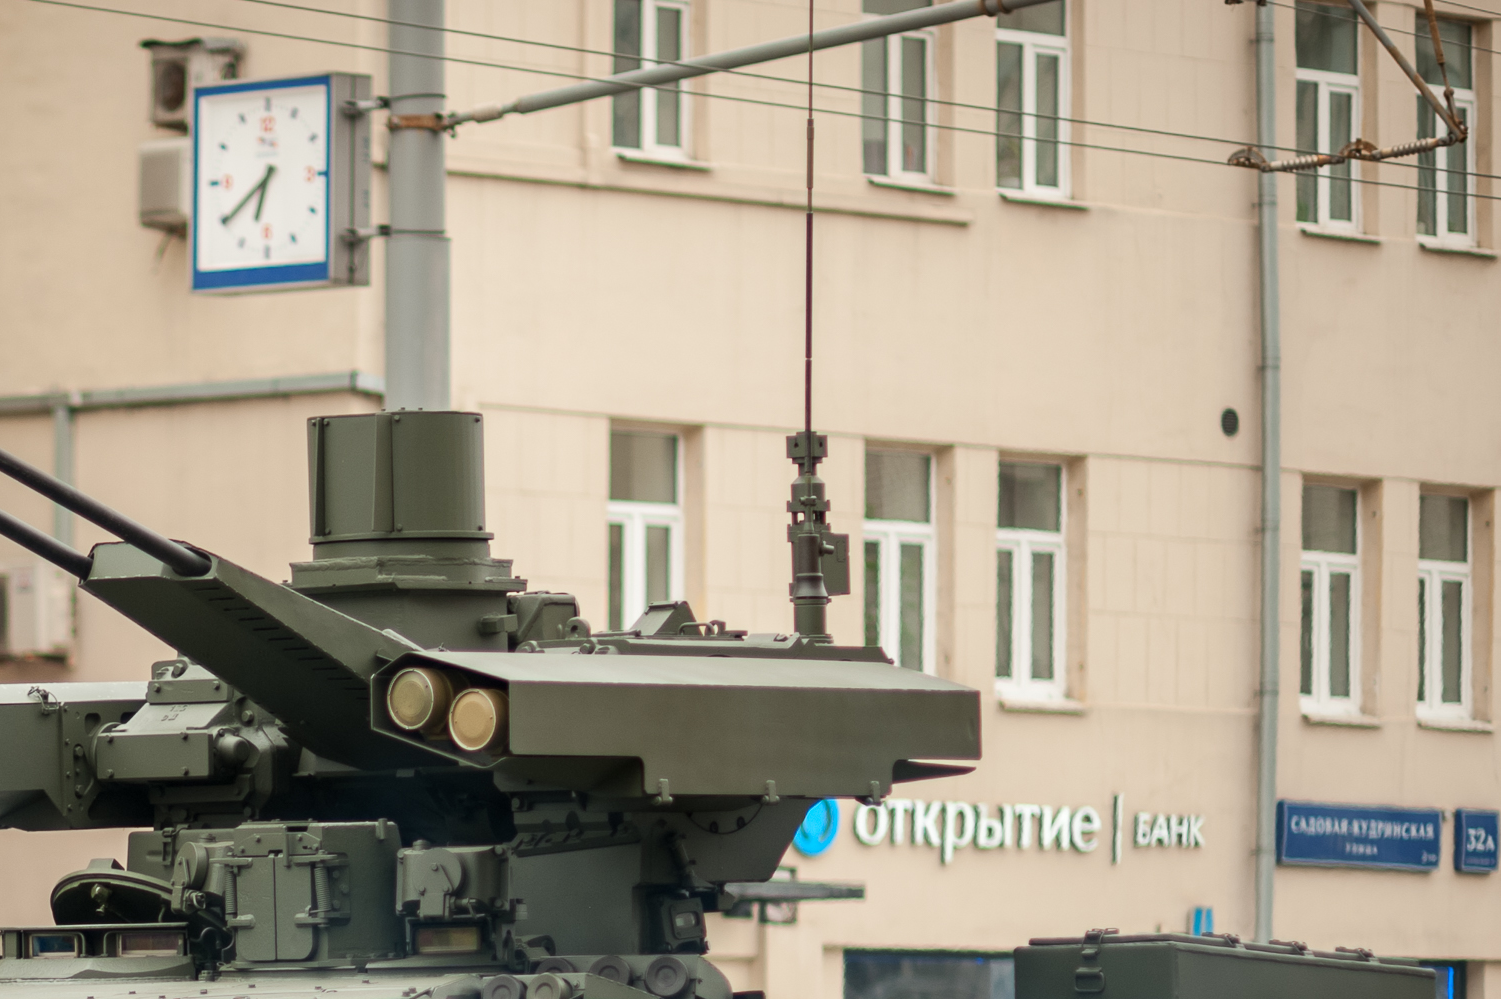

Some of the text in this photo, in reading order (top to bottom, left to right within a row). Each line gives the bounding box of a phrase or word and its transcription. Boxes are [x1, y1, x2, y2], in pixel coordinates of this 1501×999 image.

[854, 798, 1207, 864] открытие БАНК
[1290, 815, 1435, 840] САДОВАЯ-КУДРИНСКАЯ
